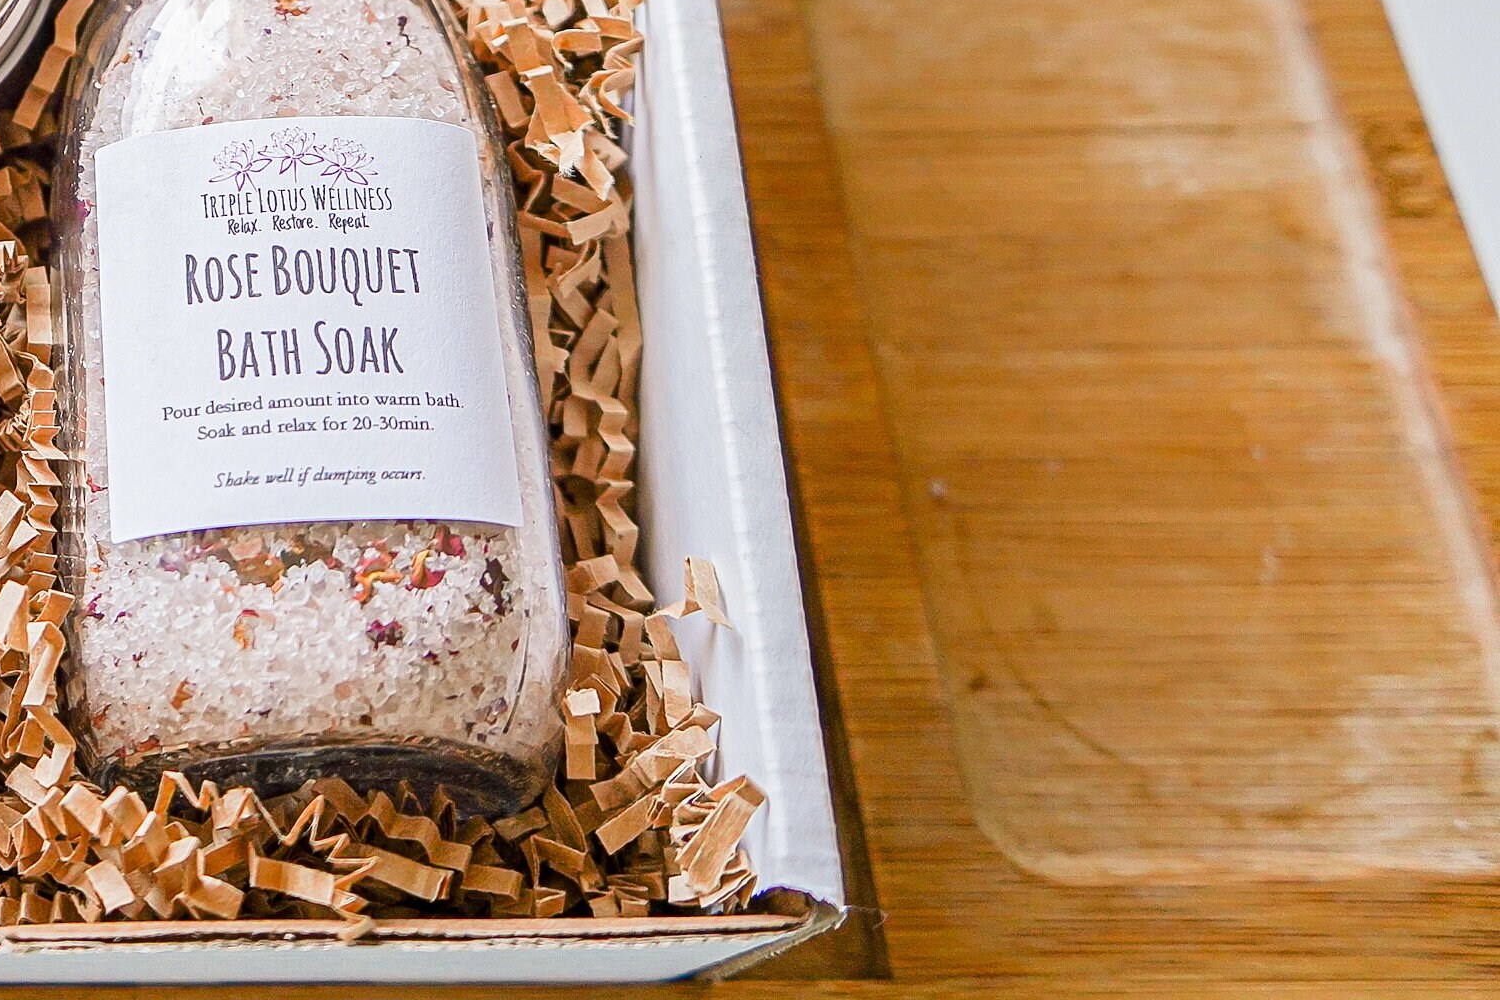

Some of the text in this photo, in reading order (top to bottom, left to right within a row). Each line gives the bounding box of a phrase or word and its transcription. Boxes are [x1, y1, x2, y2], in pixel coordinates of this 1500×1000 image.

[200, 184, 393, 219] TRIPLE LOTUS WELLNESS
[227, 218, 262, 235] Relax.
[272, 213, 319, 232] Restore.
[184, 244, 421, 307] ROSE BOUQUET
[216, 320, 405, 381] BATH SOAK
[162, 391, 465, 421] Pour desired amount into warm bath.
[197, 416, 436, 440] Soak and relax for 20-30min.
[214, 471, 260, 488] Shake
[265, 467, 294, 485] well
[297, 466, 312, 487] if
[380, 469, 426, 481] occurs.
